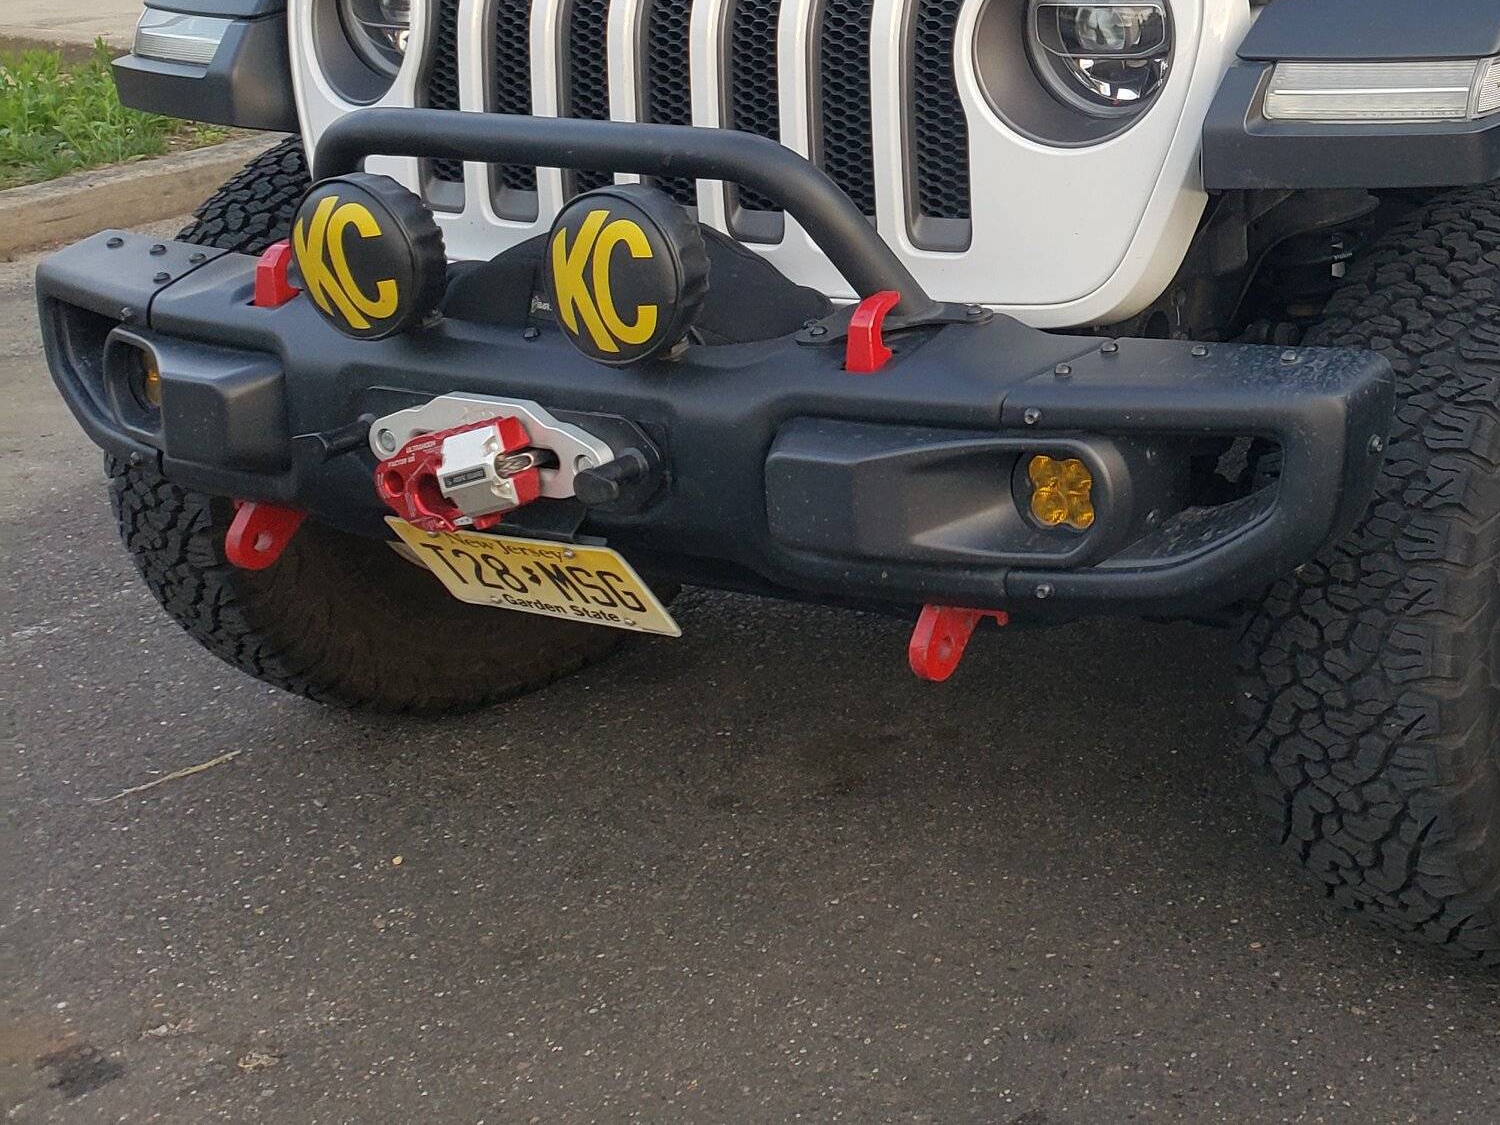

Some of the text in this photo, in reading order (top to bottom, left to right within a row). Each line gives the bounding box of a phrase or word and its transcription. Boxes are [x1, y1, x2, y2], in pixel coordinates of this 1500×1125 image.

[294, 195, 398, 330] KC
[552, 210, 658, 353] KC
[445, 532, 564, 562] New Jersey
[503, 593, 621, 623] Garden State
